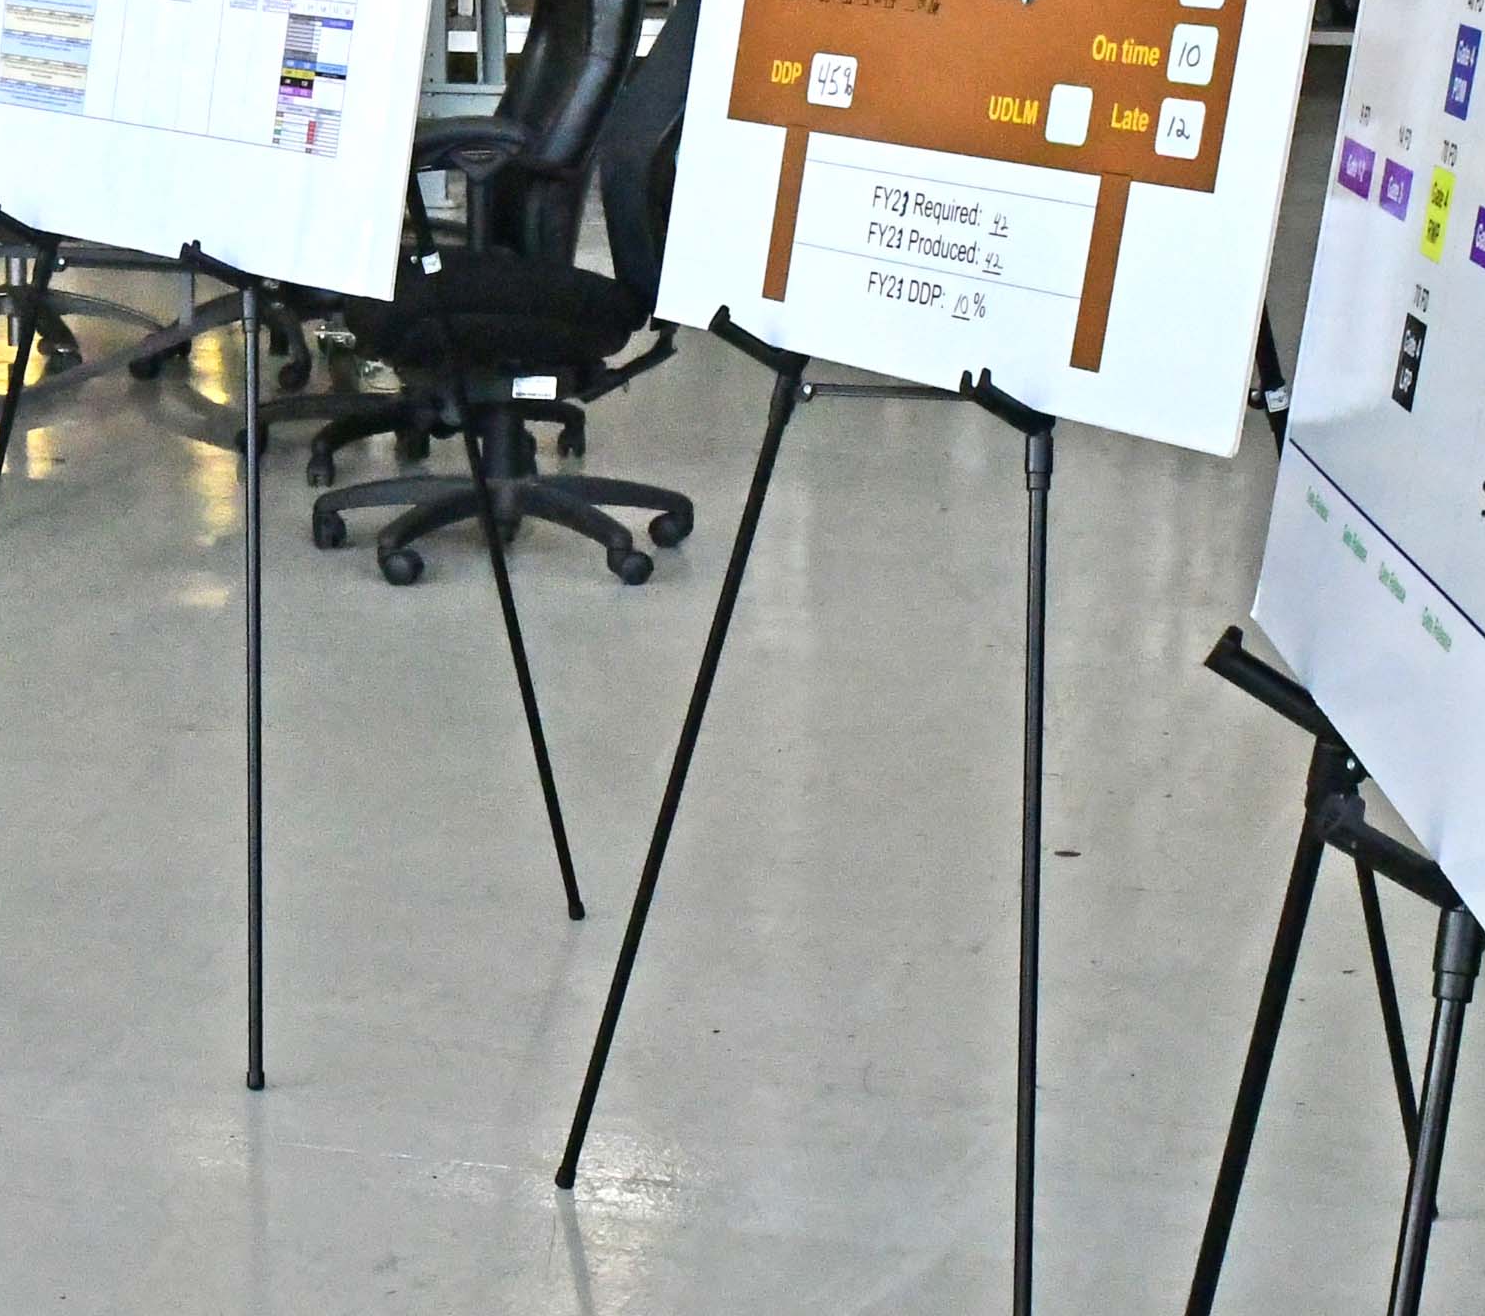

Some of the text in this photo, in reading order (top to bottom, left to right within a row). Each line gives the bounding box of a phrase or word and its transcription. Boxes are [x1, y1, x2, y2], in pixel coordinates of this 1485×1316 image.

[1092, 34, 1161, 67] On time
[1178, 42, 1201, 68] 10
[771, 59, 803, 84] DDP
[988, 95, 1040, 125] UDLM
[1110, 103, 1150, 133] Late
[1167, 116, 1190, 140] 12
[913, 192, 982, 226] Required:
[993, 212, 1009, 237] 42
[908, 229, 980, 265] Produced:
[985, 251, 1004, 270] 42
[908, 279, 946, 309] DDP:
